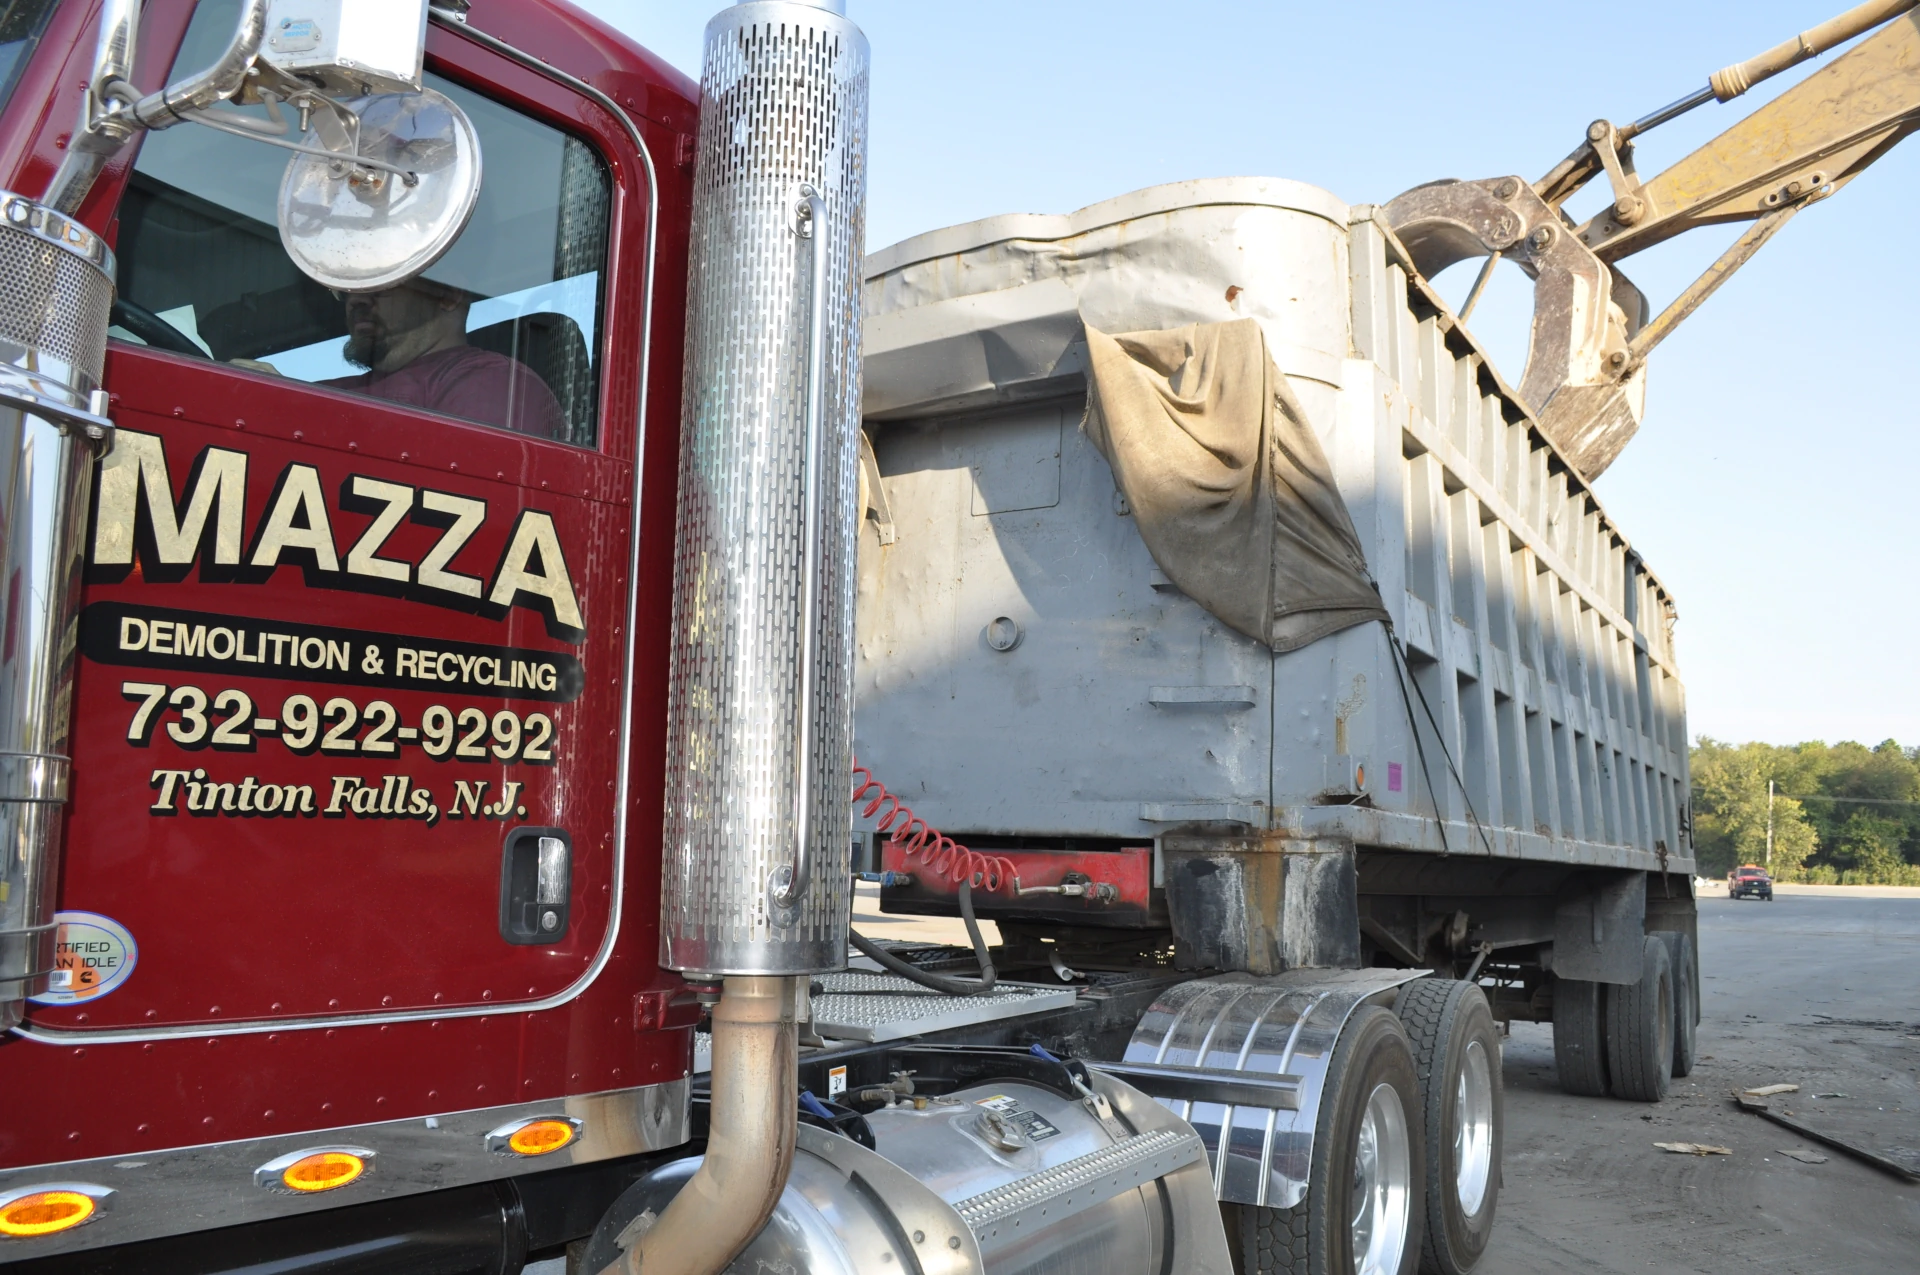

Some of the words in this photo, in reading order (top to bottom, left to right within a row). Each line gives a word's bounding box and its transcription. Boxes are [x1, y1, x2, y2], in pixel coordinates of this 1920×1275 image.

[93, 429, 585, 630] MAZZA
[119, 616, 350, 673] DEMOLITION
[361, 644, 385, 675] &
[395, 647, 557, 691] RECYCLING
[122, 682, 552, 760] 732-922-9292
[151, 769, 314, 814] Tinton
[323, 776, 438, 822] Falls,
[447, 780, 526, 815] N.J.
[82, 957, 117, 968] IDLE
